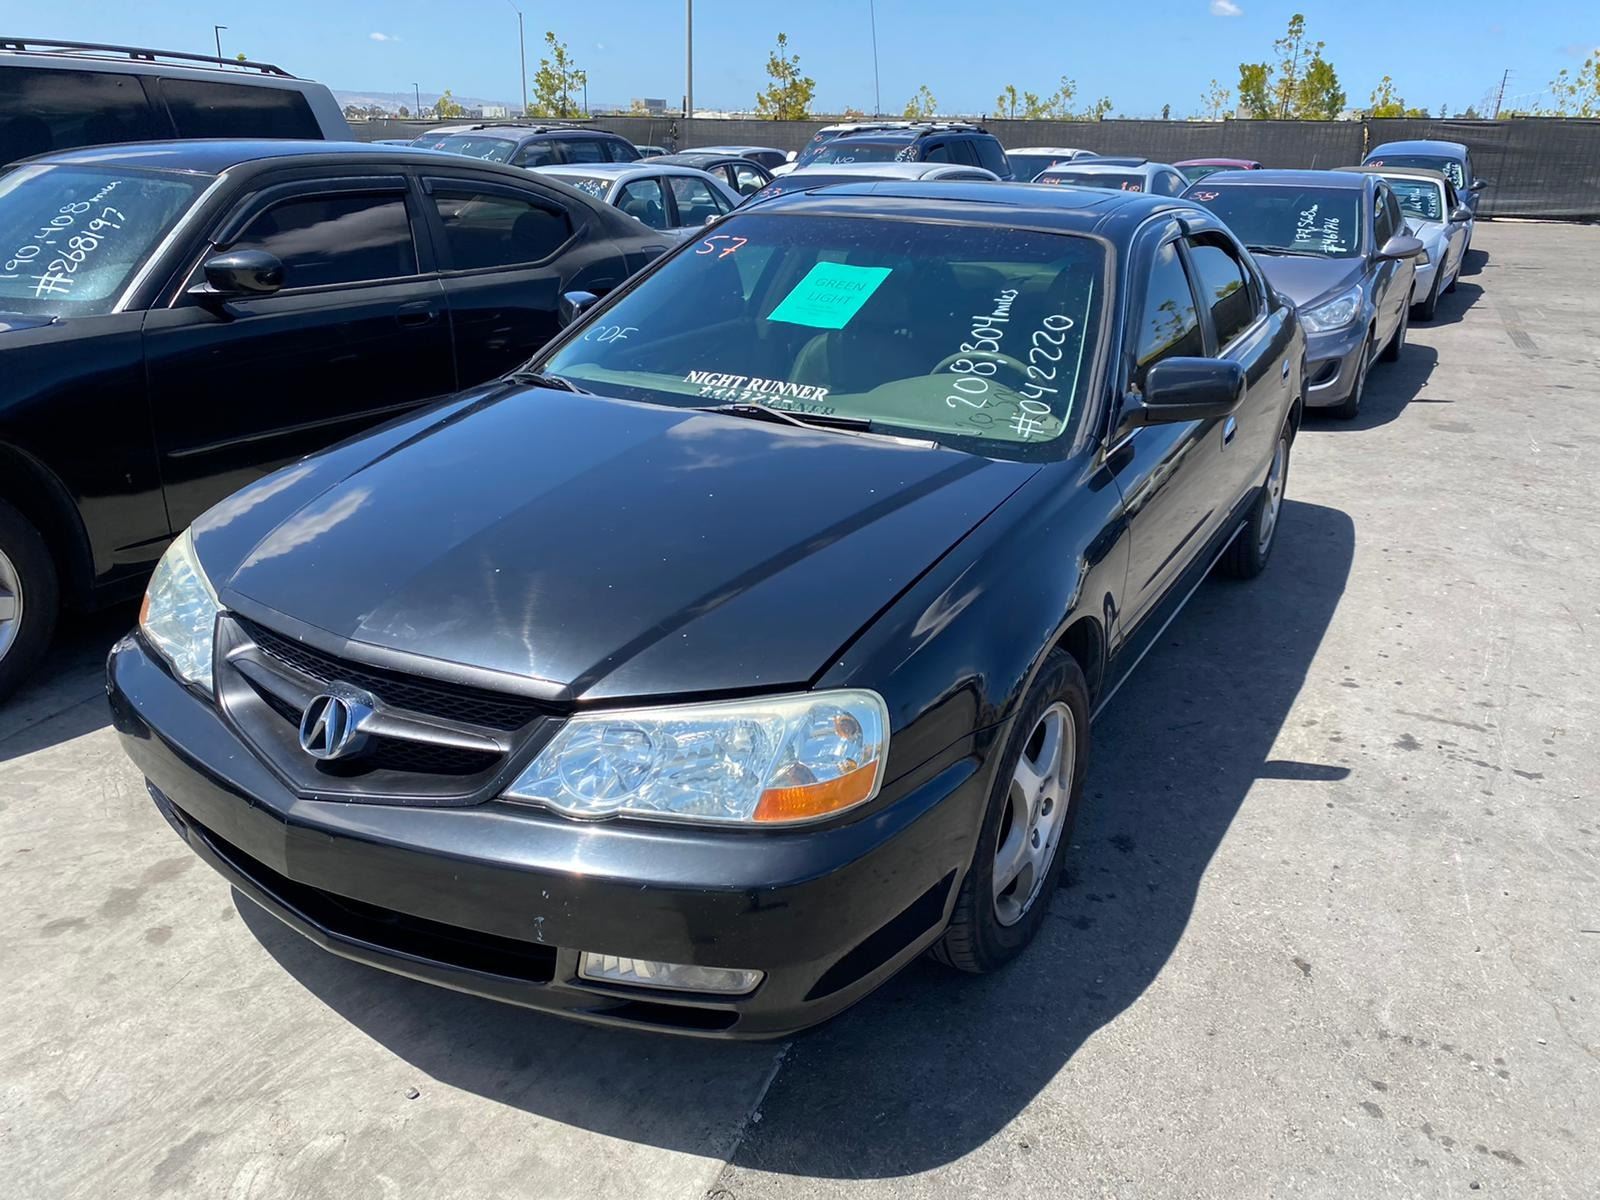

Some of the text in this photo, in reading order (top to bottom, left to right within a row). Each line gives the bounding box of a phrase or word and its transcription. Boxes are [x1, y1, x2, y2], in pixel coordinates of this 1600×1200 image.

[28, 206, 125, 297] #268197
[695, 235, 748, 259] 57
[806, 291, 853, 305] LIGHT
[814, 278, 867, 292] GREEN
[583, 325, 640, 344] CDF
[946, 288, 1019, 408] 208,304 miles
[682, 370, 830, 402] NIGHT RUNNER
[1009, 314, 1074, 438] #042220
